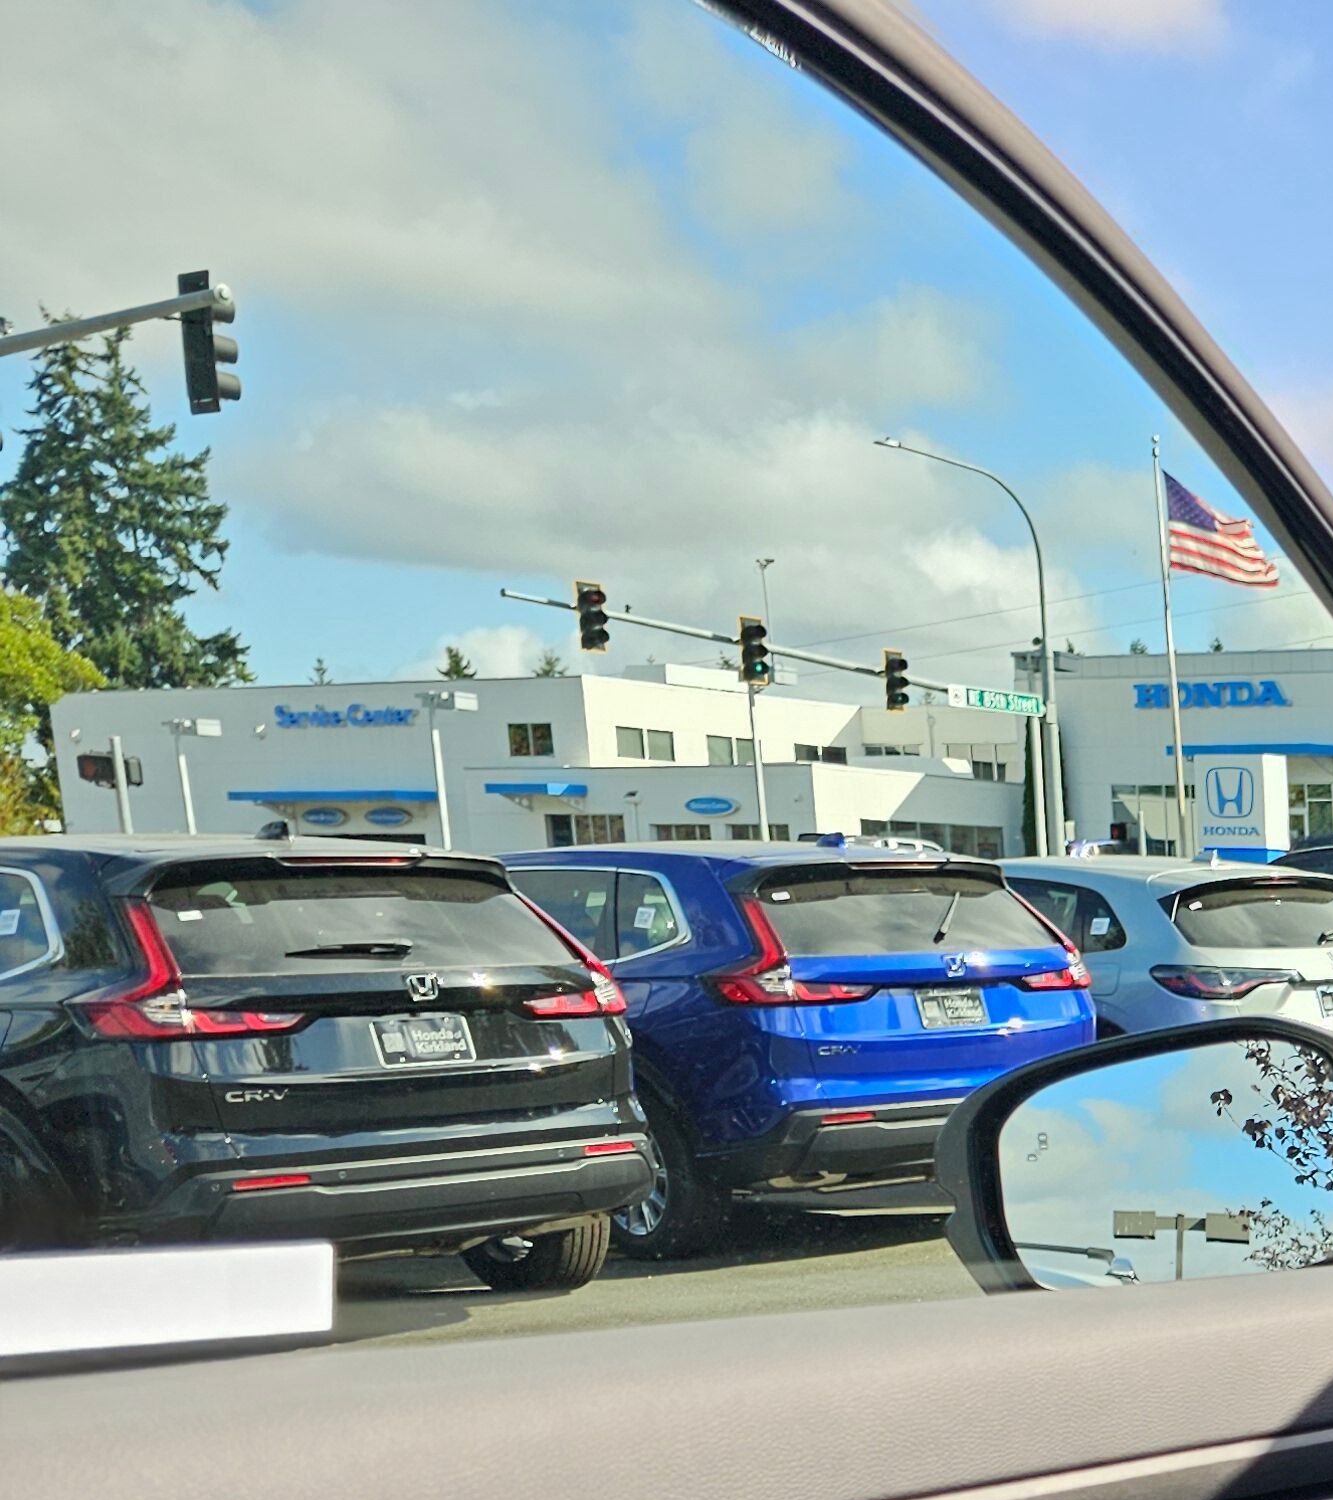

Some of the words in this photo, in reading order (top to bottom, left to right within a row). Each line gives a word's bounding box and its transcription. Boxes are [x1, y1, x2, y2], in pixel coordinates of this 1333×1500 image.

[968, 689, 981, 706] NE
[983, 691, 1007, 709] 85th
[1008, 694, 1038, 714] Street
[1133, 680, 1290, 709] HONDA
[274, 703, 343, 729] Service
[347, 703, 415, 728] Center
[1203, 826, 1261, 837] HONDA
[411, 1028, 454, 1042] Honda
[415, 1038, 468, 1054] Kirkland
[225, 1088, 289, 1103] CR-V
